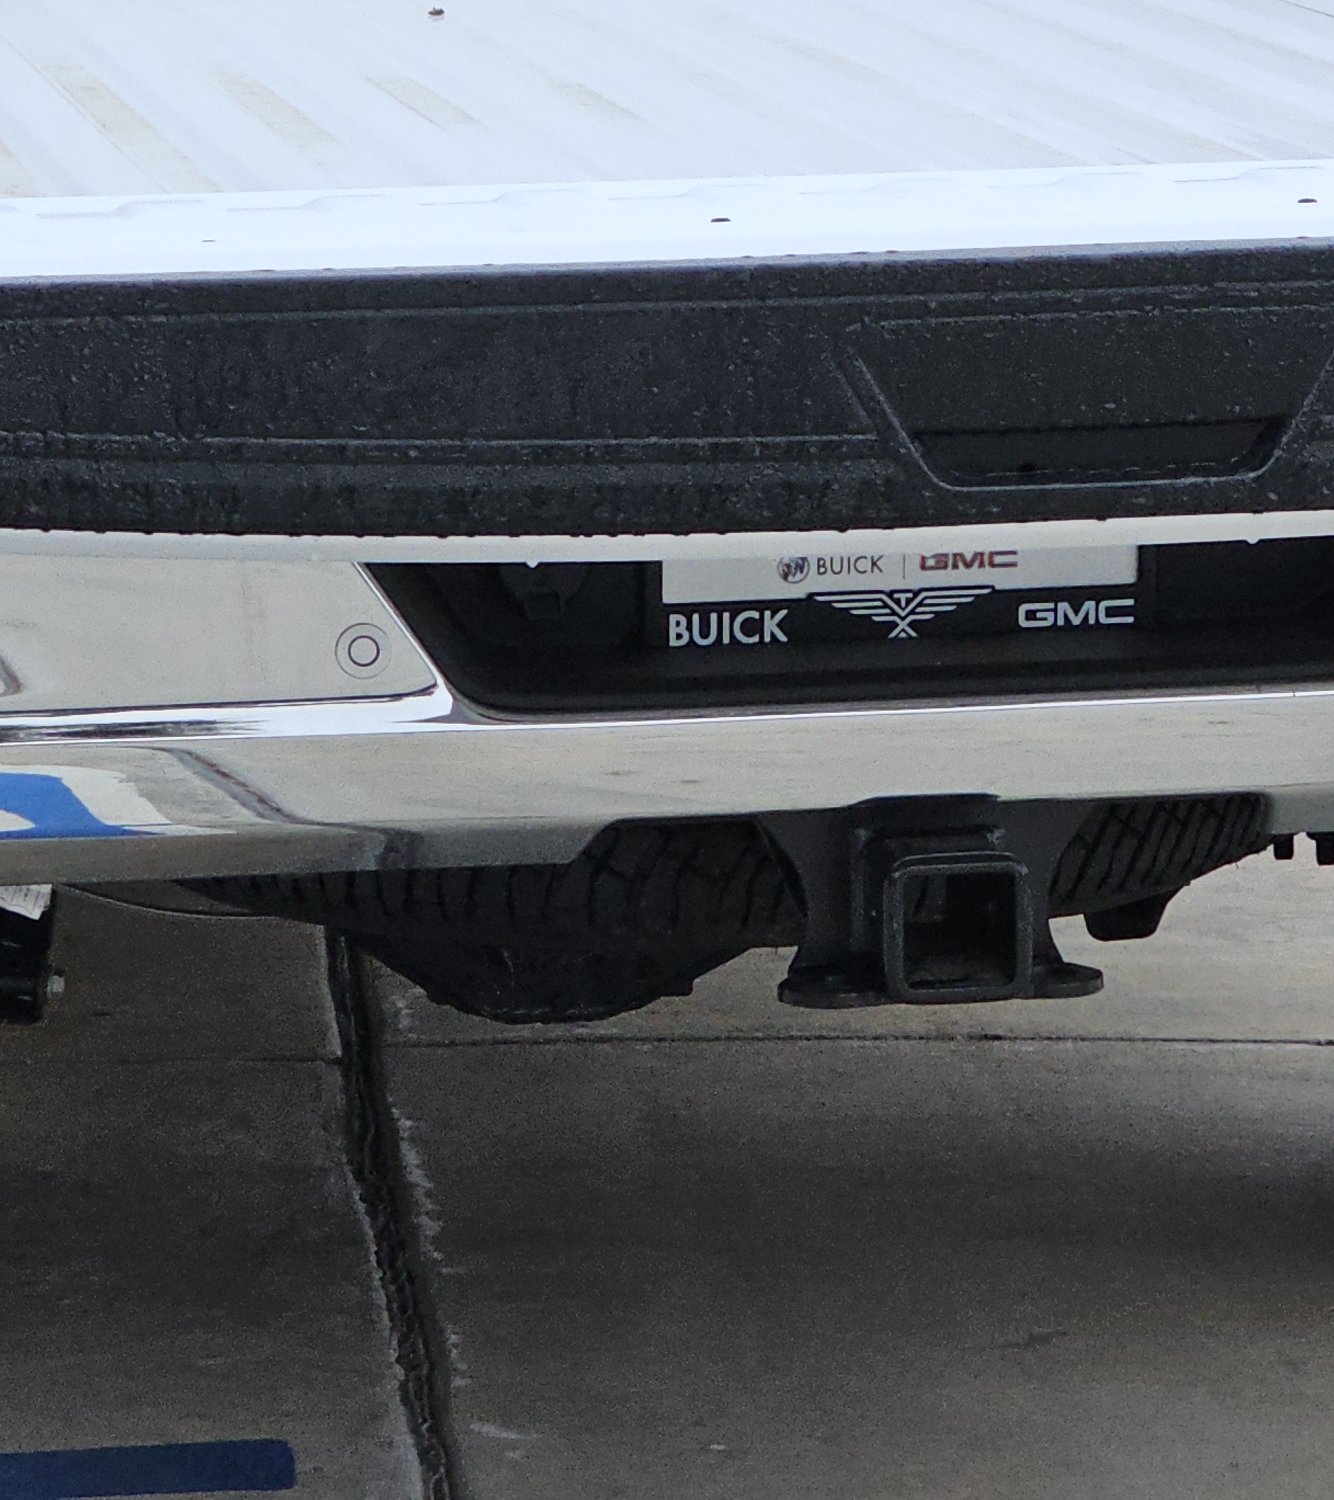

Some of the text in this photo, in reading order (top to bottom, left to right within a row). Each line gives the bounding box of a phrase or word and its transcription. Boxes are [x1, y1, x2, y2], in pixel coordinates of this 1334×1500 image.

[816, 550, 1018, 576] BUICK GMC
[669, 609, 789, 647] BUICK
[1018, 598, 1135, 628] GMC
